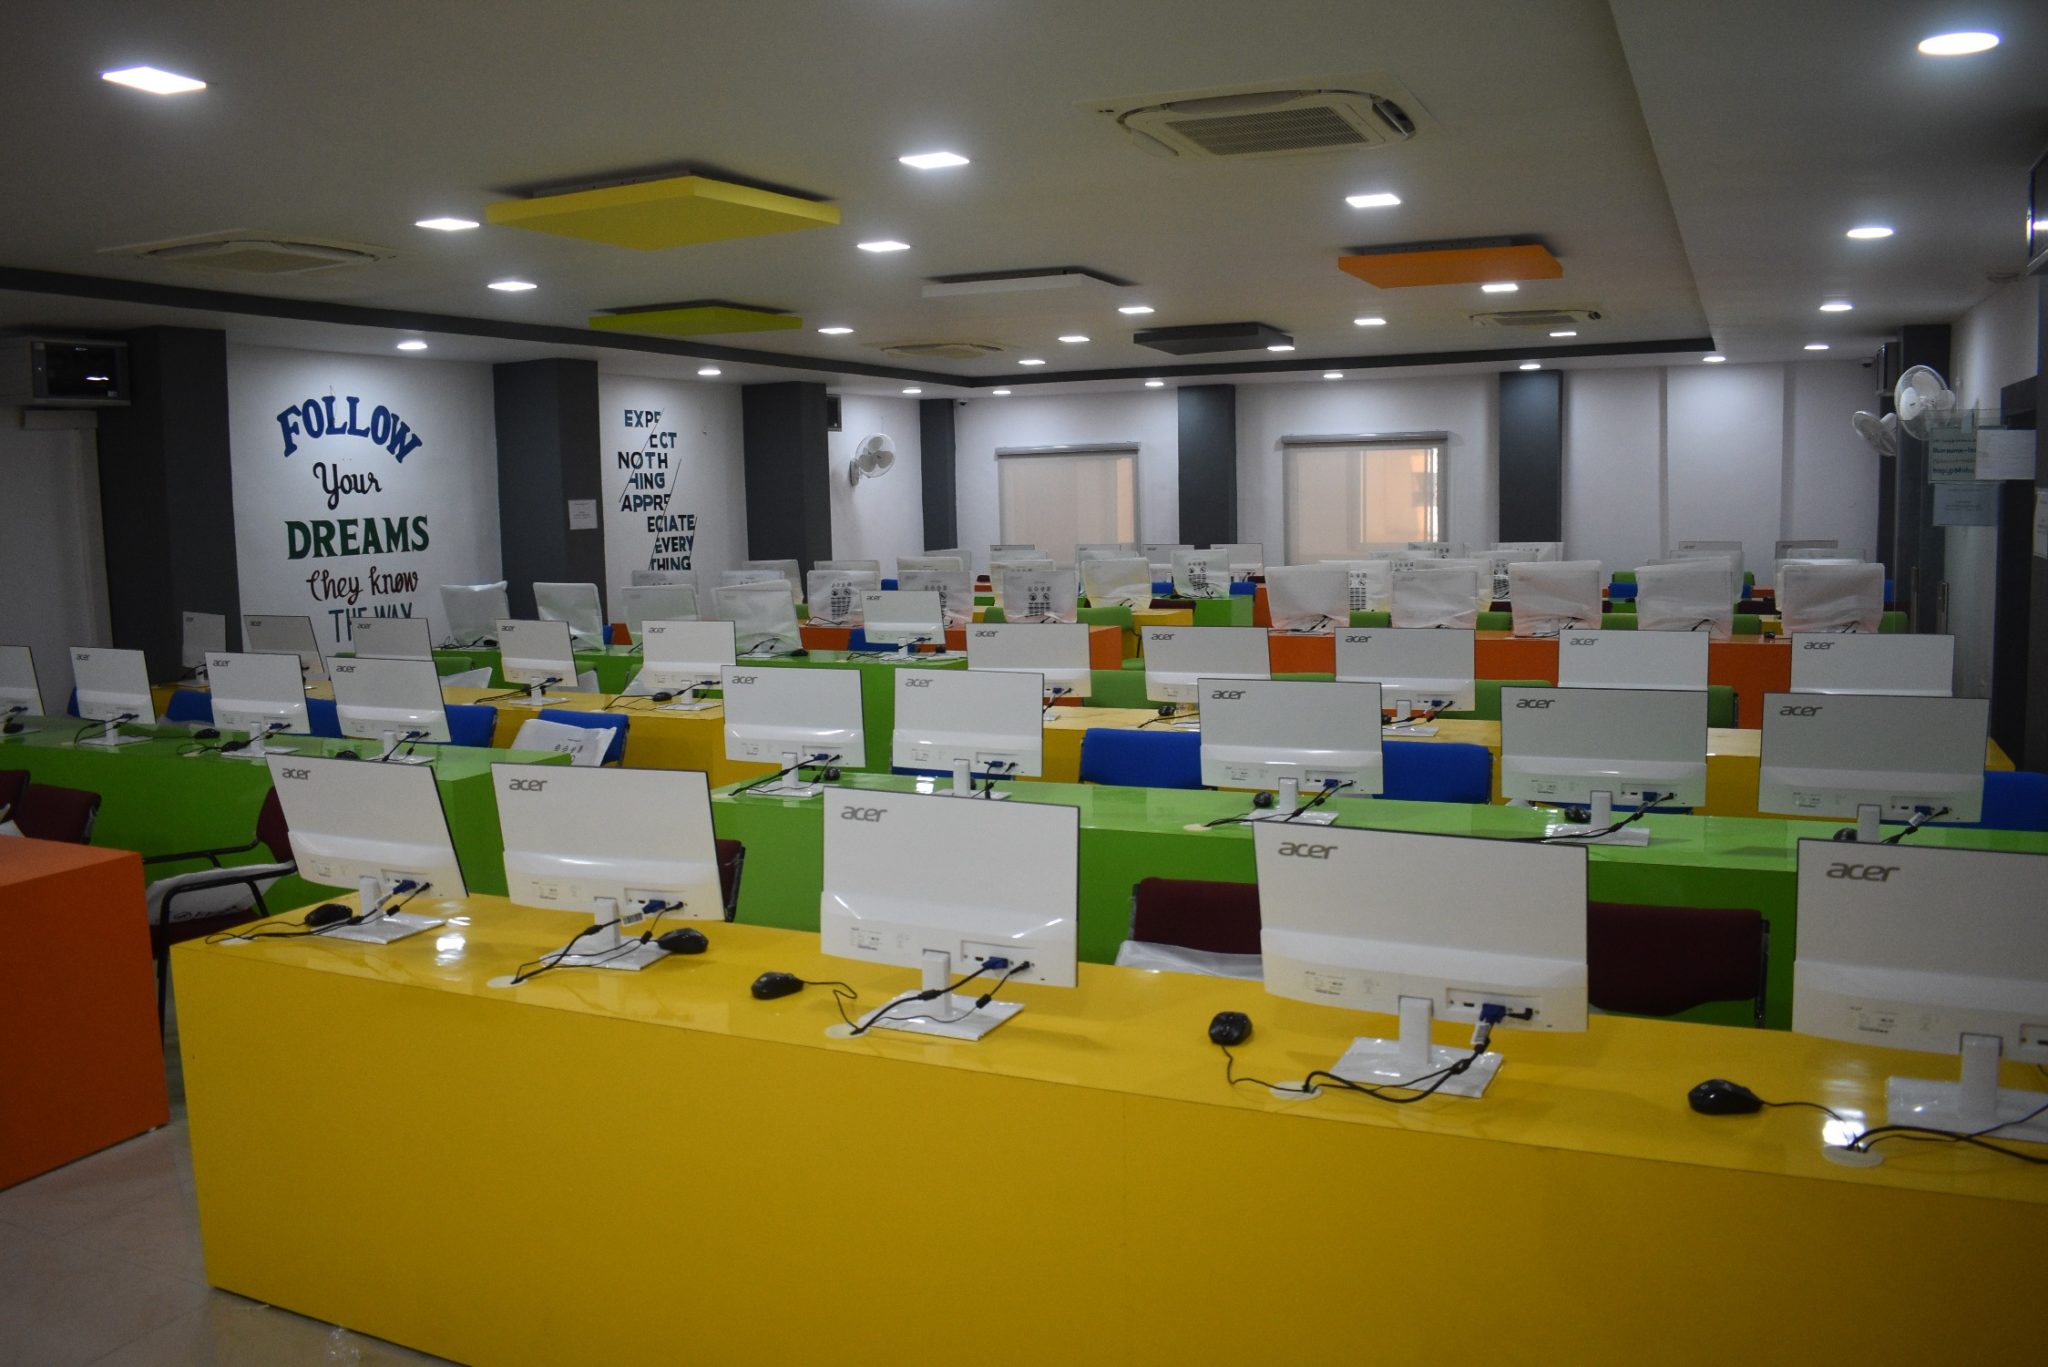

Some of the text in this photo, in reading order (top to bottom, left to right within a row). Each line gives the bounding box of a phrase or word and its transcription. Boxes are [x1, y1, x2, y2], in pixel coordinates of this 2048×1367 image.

[277, 395, 423, 463] FOLLOW
[618, 451, 668, 470] NOTH
[312, 461, 383, 511] Your
[647, 514, 695, 533] ECIATE
[284, 514, 430, 560] DREAMS
[655, 535, 694, 554] EVERY
[650, 555, 691, 571] THING
[368, 566, 419, 596] know
[975, 630, 999, 638] acer
[1150, 633, 1175, 641] acer
[1344, 635, 1372, 644] acer
[1569, 637, 1599, 646] acer
[1803, 641, 1836, 650] acer
[212, 659, 231, 667] acer
[335, 665, 357, 673] acer
[731, 675, 759, 685] acer
[904, 678, 934, 688] acer
[1211, 689, 1246, 700] acer
[1515, 698, 1556, 709] acer
[1779, 705, 1823, 717] acer
[281, 767, 311, 781] acer
[509, 778, 548, 792] acer
[840, 805, 888, 822] acer
[1278, 841, 1339, 859] acer
[1826, 863, 1901, 882] acer
